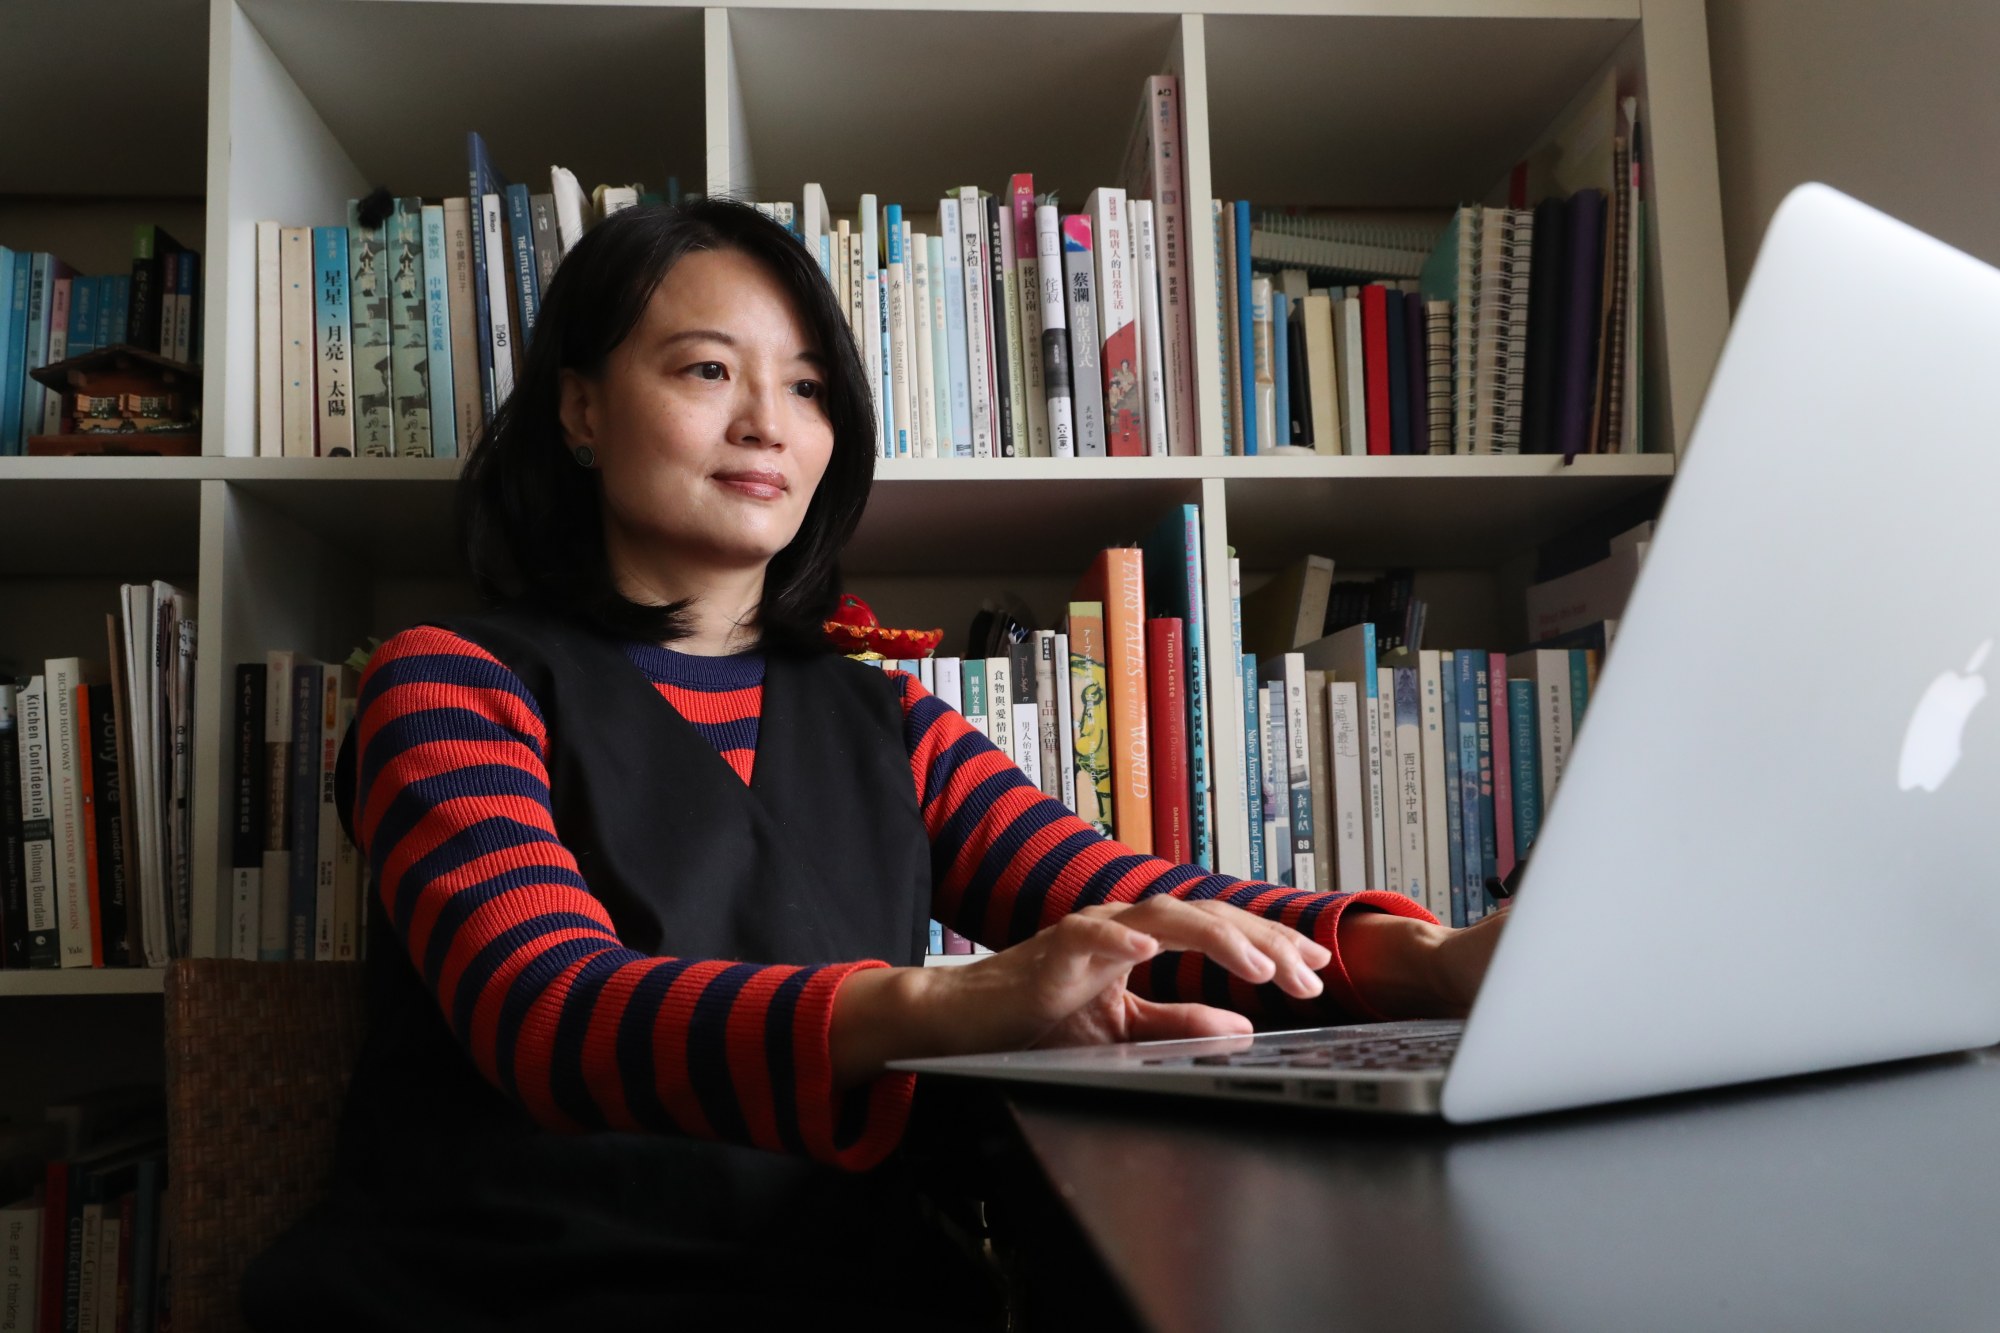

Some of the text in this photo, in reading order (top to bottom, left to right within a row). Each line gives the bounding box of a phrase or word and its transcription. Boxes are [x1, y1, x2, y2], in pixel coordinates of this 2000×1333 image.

[517, 235, 527, 250] THE
[519, 251, 530, 274] LITTLE
[522, 275, 532, 294] STAR
[1023, 266, 1037, 311] 移民台南
[1109, 229, 1124, 310] 隋唐人的日常生活
[430, 277, 444, 352] 中國文化要義
[1073, 272, 1094, 368] 蔡瀾的生活方式
[325, 269, 345, 417] 星星、月亮、太陽
[1122, 561, 1140, 613] FAIRY
[1125, 619, 1143, 678] TALES
[57, 672, 68, 716] RICHARD
[243, 673, 252, 716] FACT
[970, 675, 980, 715] 圓神文叢
[995, 670, 1008, 756] 食物與愛情的
[1167, 631, 1179, 780] Timor-Leste Land of Discovery
[59, 718, 71, 771] HOLLOWAY
[1247, 729, 1258, 753] Native
[1292, 686, 1304, 760] 帶一本書去巴黎
[26, 694, 46, 819] Kitchen Confidential
[1130, 725, 1149, 798] WORLD
[1191, 646, 1206, 855] THIS IS PRAGUE
[1516, 688, 1535, 839] MY FIRST NEW YORK
[1248, 756, 1259, 796] American
[1403, 752, 1418, 824] 西行找中國
[63, 786, 73, 819] LITTLE
[101, 712, 124, 905] Jony Ive Leander Kahney
[1250, 799, 1260, 818] Tales
[64, 822, 76, 864] HISTORY
[1251, 821, 1261, 837] and
[1297, 840, 1310, 850] 69
[67, 866, 76, 879] OF
[1251, 840, 1262, 874] Legends
[30, 844, 46, 928] Anthony Bourdain
[68, 882, 79, 930] RELIGION
[67, 946, 83, 954] Yale
[3, 1222, 23, 1330] the art of thinking
